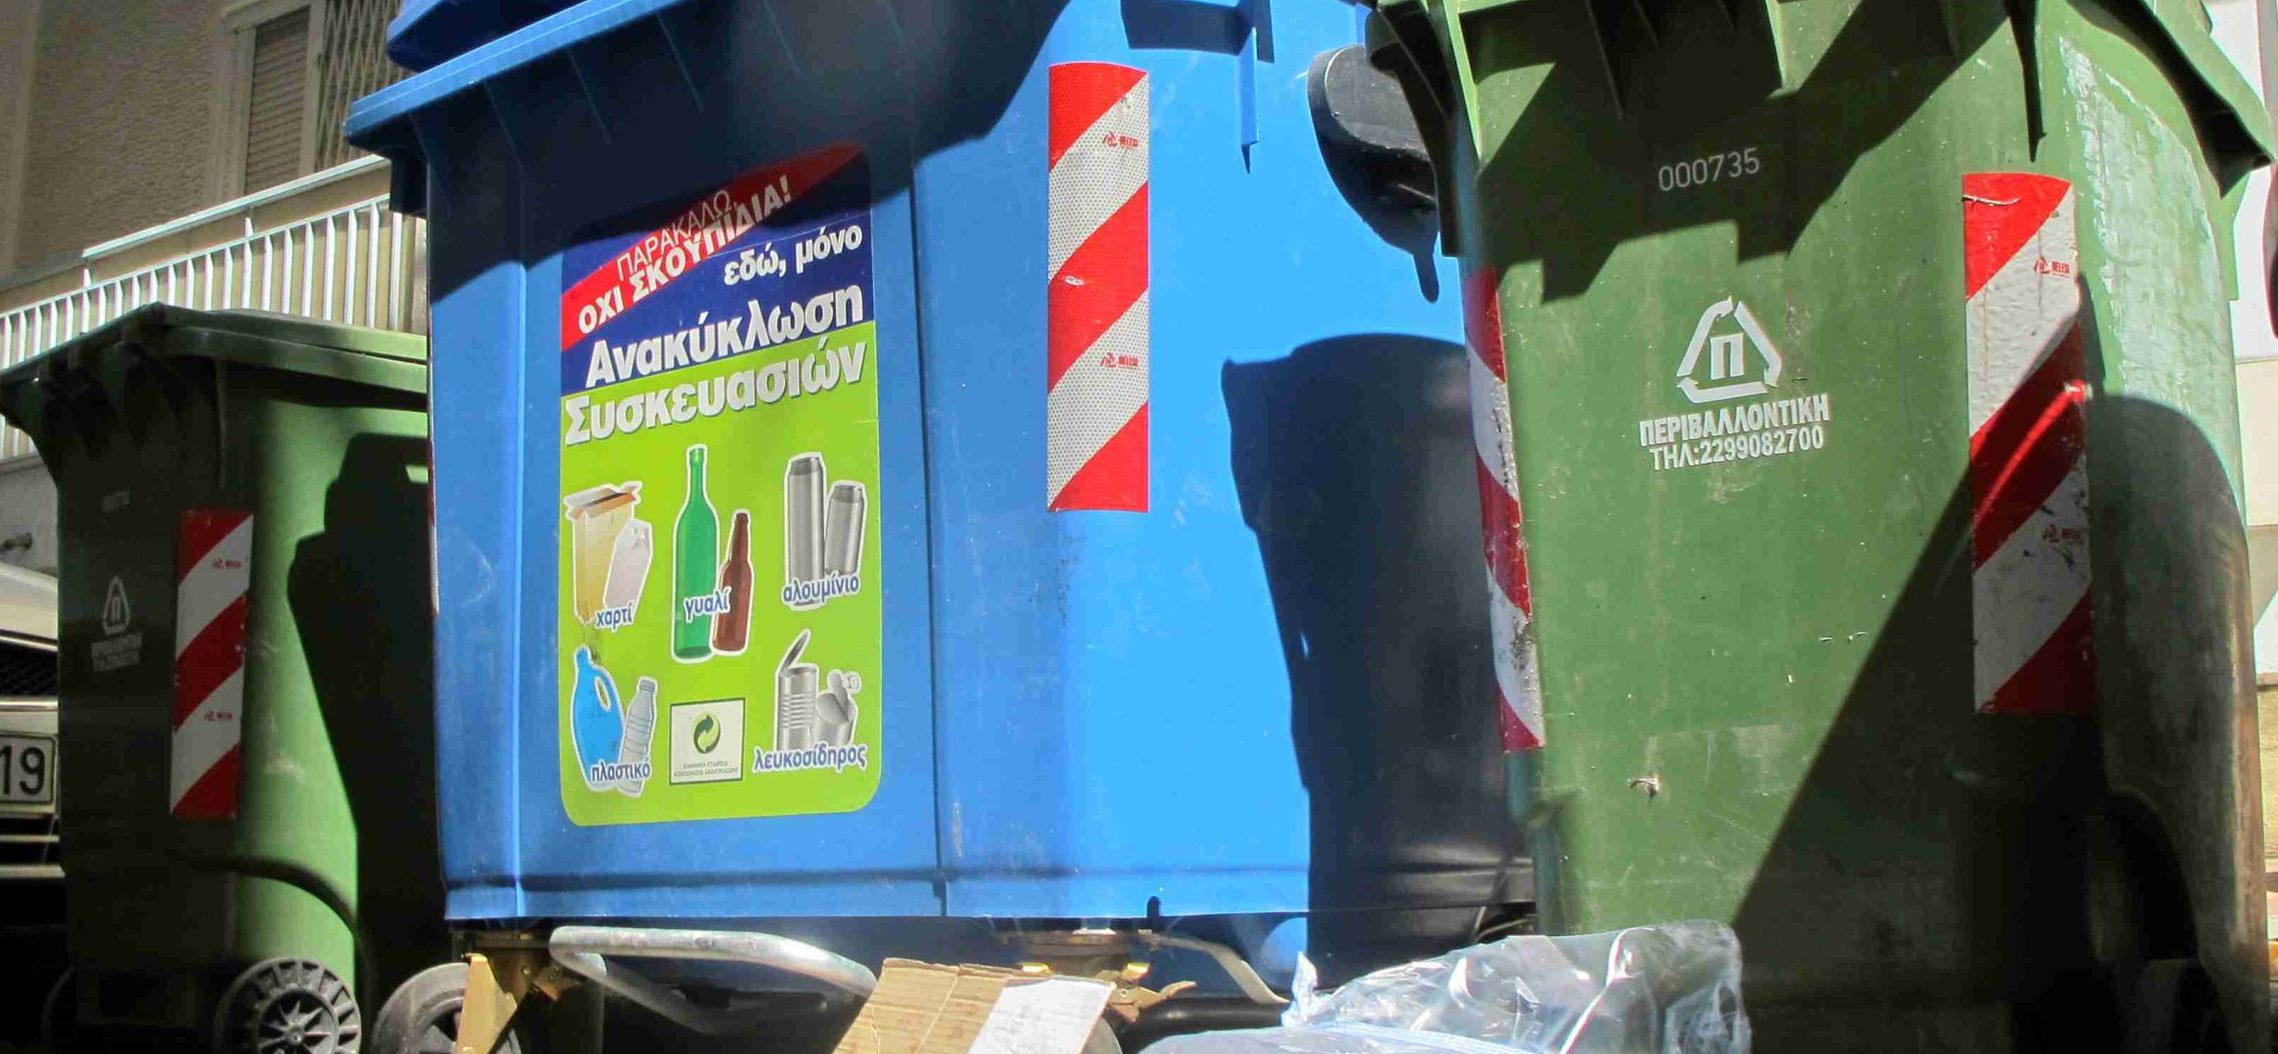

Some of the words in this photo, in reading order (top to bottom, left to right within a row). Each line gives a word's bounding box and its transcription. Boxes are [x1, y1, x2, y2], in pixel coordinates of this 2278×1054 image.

[1658, 148, 1760, 191] 000735
[724, 243, 786, 286] εδώ,
[795, 224, 863, 273] μόνο
[578, 289, 625, 335] ΟΧΙ
[585, 285, 864, 388] Ανακύκλωση
[564, 338, 867, 446] Συσκευασιών
[1639, 393, 1830, 446] ΠΕΡΙΒΑΛΛΟΝΤΙΚΗ
[1650, 425, 1824, 471] ΤΗΛ:2299082700
[684, 591, 731, 621] γυαλί
[783, 577, 859, 605] αλουμίνιο
[596, 606, 633, 630] χαρτί
[591, 759, 650, 783] πλαστικό
[754, 744, 866, 772] λευκοσίδηρος
